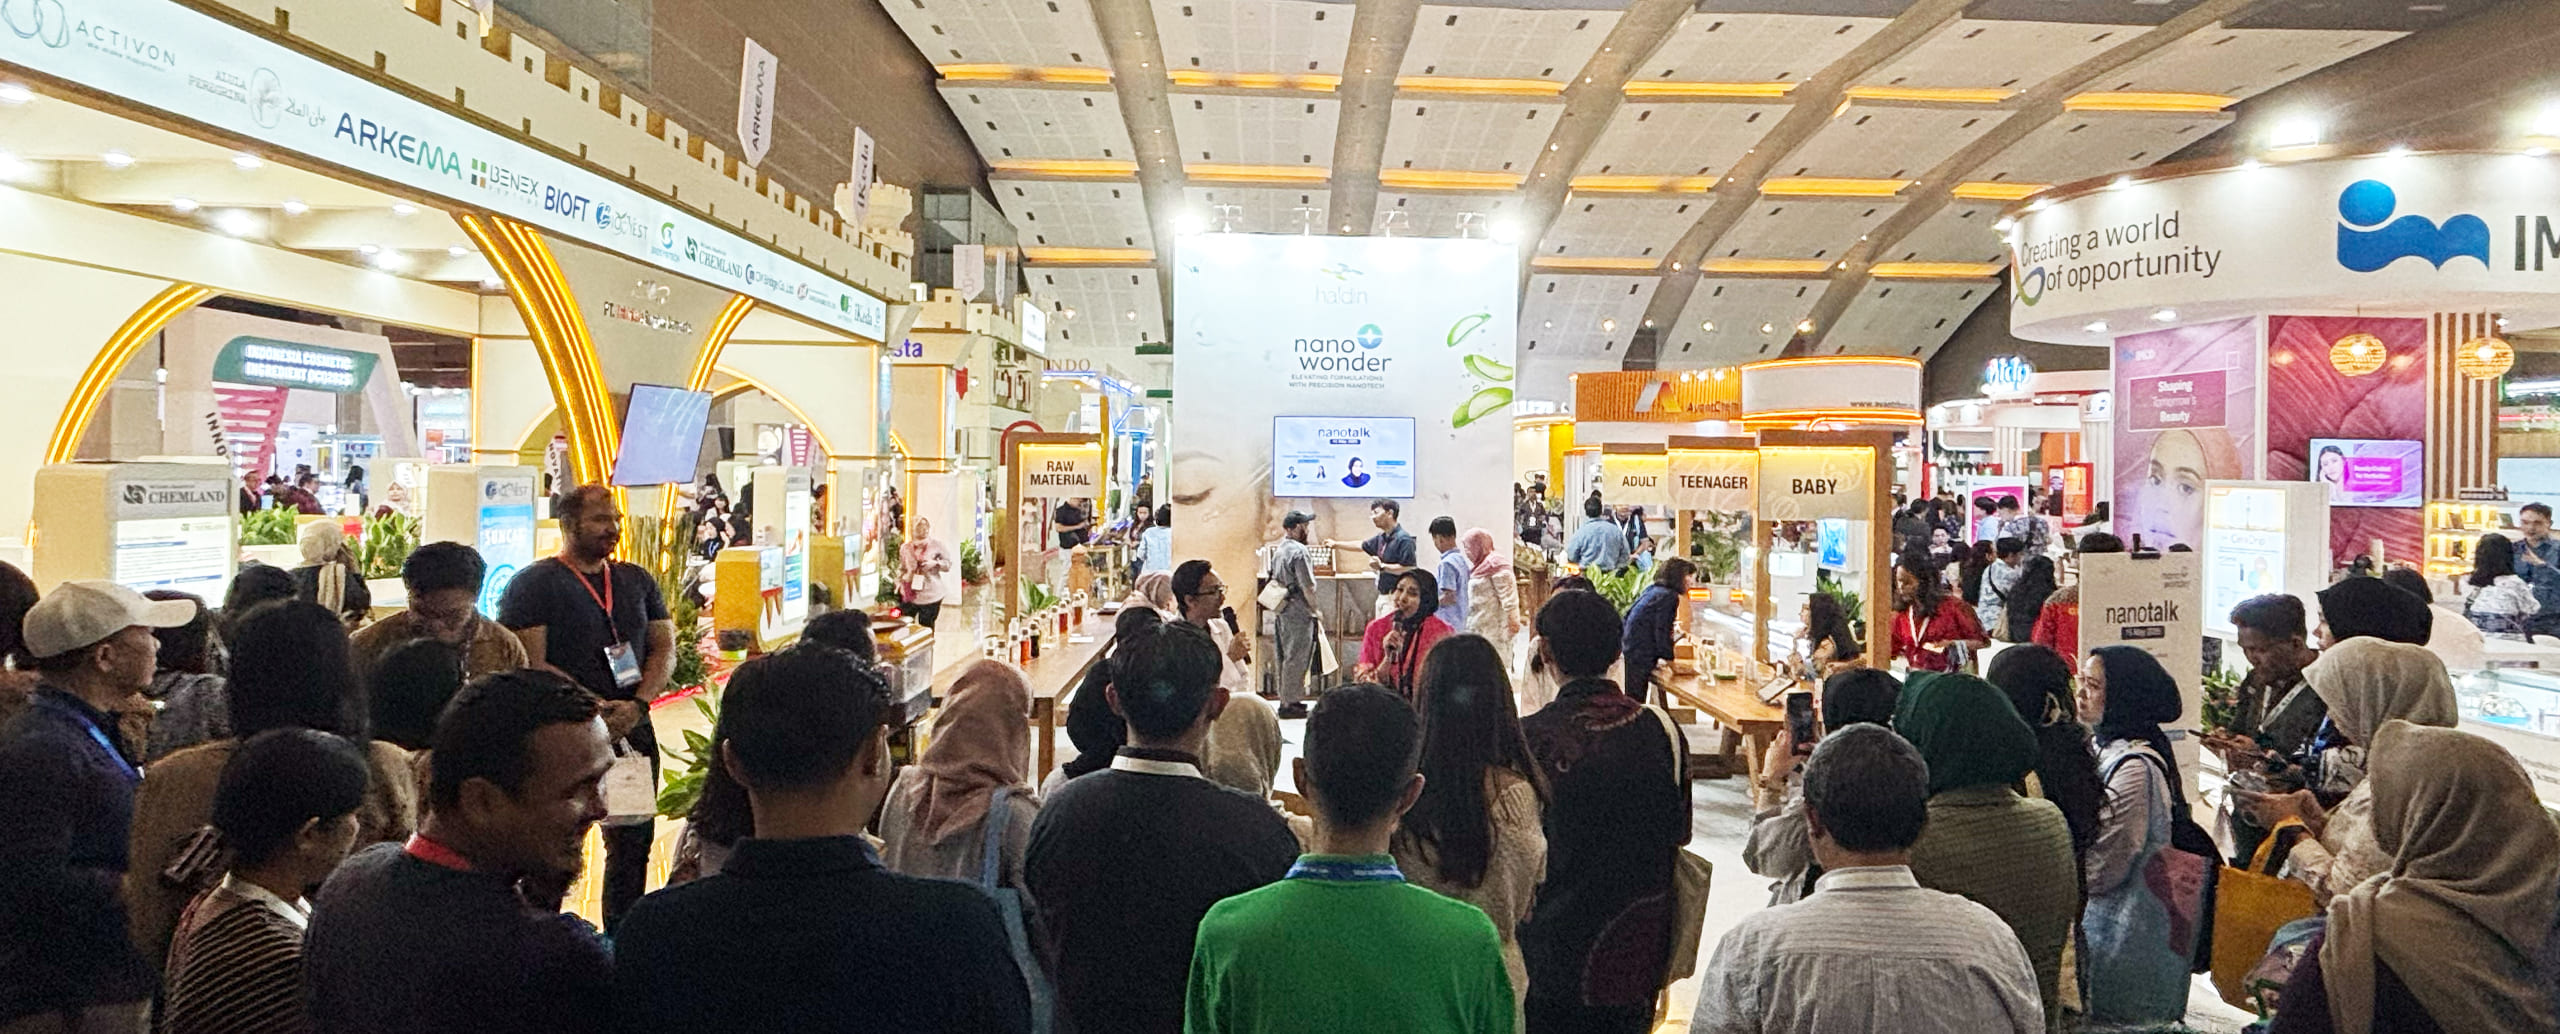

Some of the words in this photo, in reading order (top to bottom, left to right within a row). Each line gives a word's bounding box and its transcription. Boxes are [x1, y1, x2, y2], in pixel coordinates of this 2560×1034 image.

[76, 20, 176, 67] ACTIVON
[751, 60, 767, 152] ARKEMA
[334, 112, 463, 180] ARKEMA
[490, 165, 539, 198] BENEX
[543, 185, 591, 223] BIOFT
[2021, 233, 2082, 268] Creating
[2086, 230, 2099, 251] a
[2105, 210, 2180, 248] world
[699, 250, 744, 279] CHEMLAND
[2046, 264, 2063, 291] of
[2067, 244, 2222, 292] opportunity
[1314, 285, 1368, 305] haldin
[1294, 338, 1356, 354] nano
[1299, 351, 1393, 372] wonder
[1288, 381, 1307, 389] WITH
[1308, 381, 1346, 389] PRECISION
[1346, 382, 1385, 390] NANOTECH
[1291, 373, 1329, 381] ELEVATING
[1330, 374, 1384, 382] FORMULATIONS
[2158, 380, 2194, 393] Shaping
[2160, 410, 2191, 424] Beauty
[1318, 427, 1371, 438] nanotalk
[1046, 460, 1075, 472] RAW
[1030, 474, 1092, 486] MATERIAL
[1622, 475, 1659, 488] ADULT
[1680, 475, 1749, 490] TEENAGER
[1792, 478, 1838, 495] BABY
[148, 490, 226, 504] CHEMLAND
[2106, 600, 2180, 624] nanotalk
